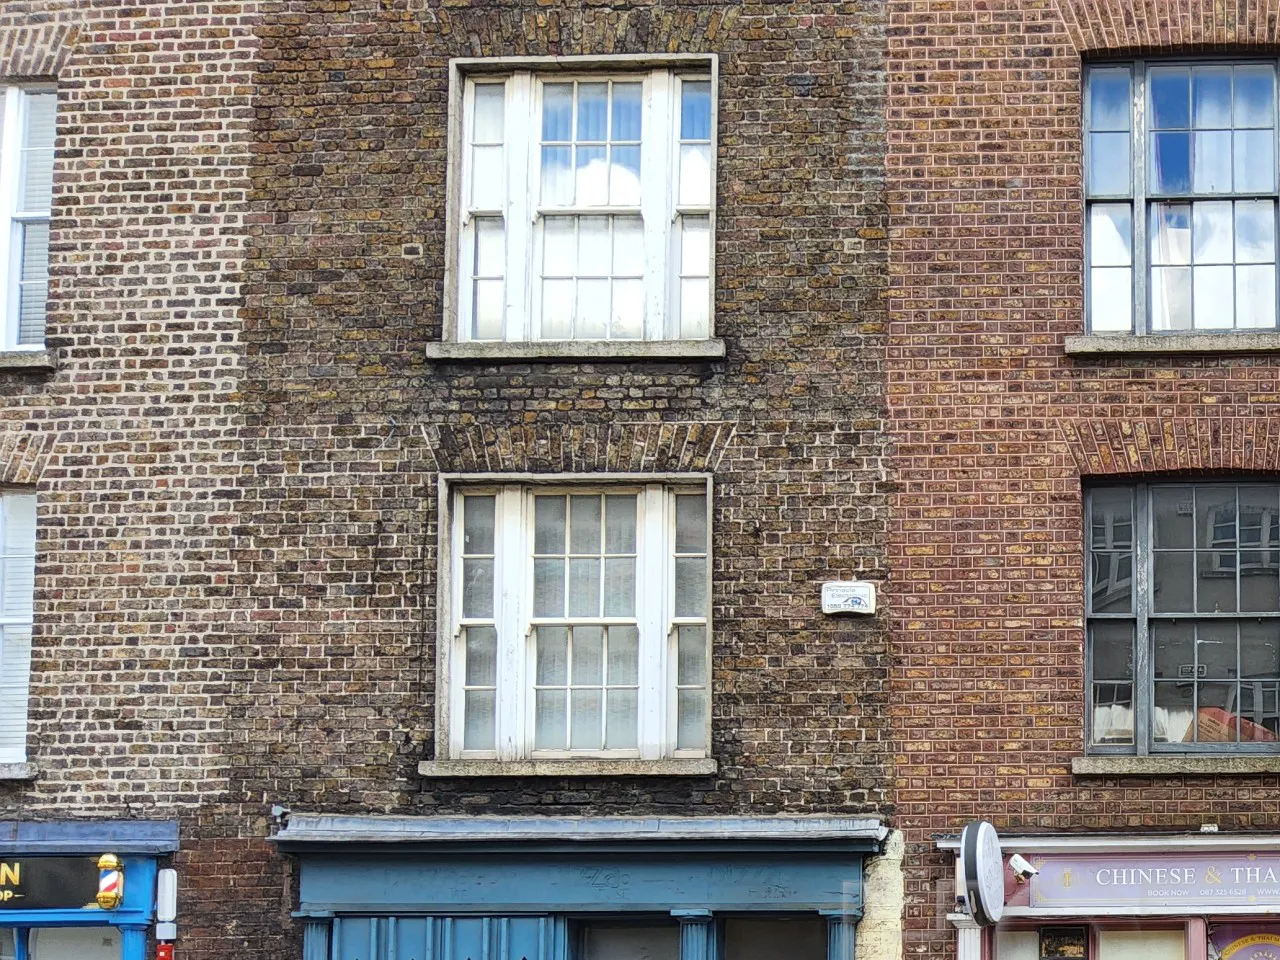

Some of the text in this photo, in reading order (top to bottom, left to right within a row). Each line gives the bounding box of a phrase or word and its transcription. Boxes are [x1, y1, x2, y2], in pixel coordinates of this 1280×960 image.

[1096, 868, 1196, 886] CHINESE
[1205, 865, 1222, 884] &
[1229, 888, 1247, 896] 6528
[1224, 937, 1250, 956] CHINESE
